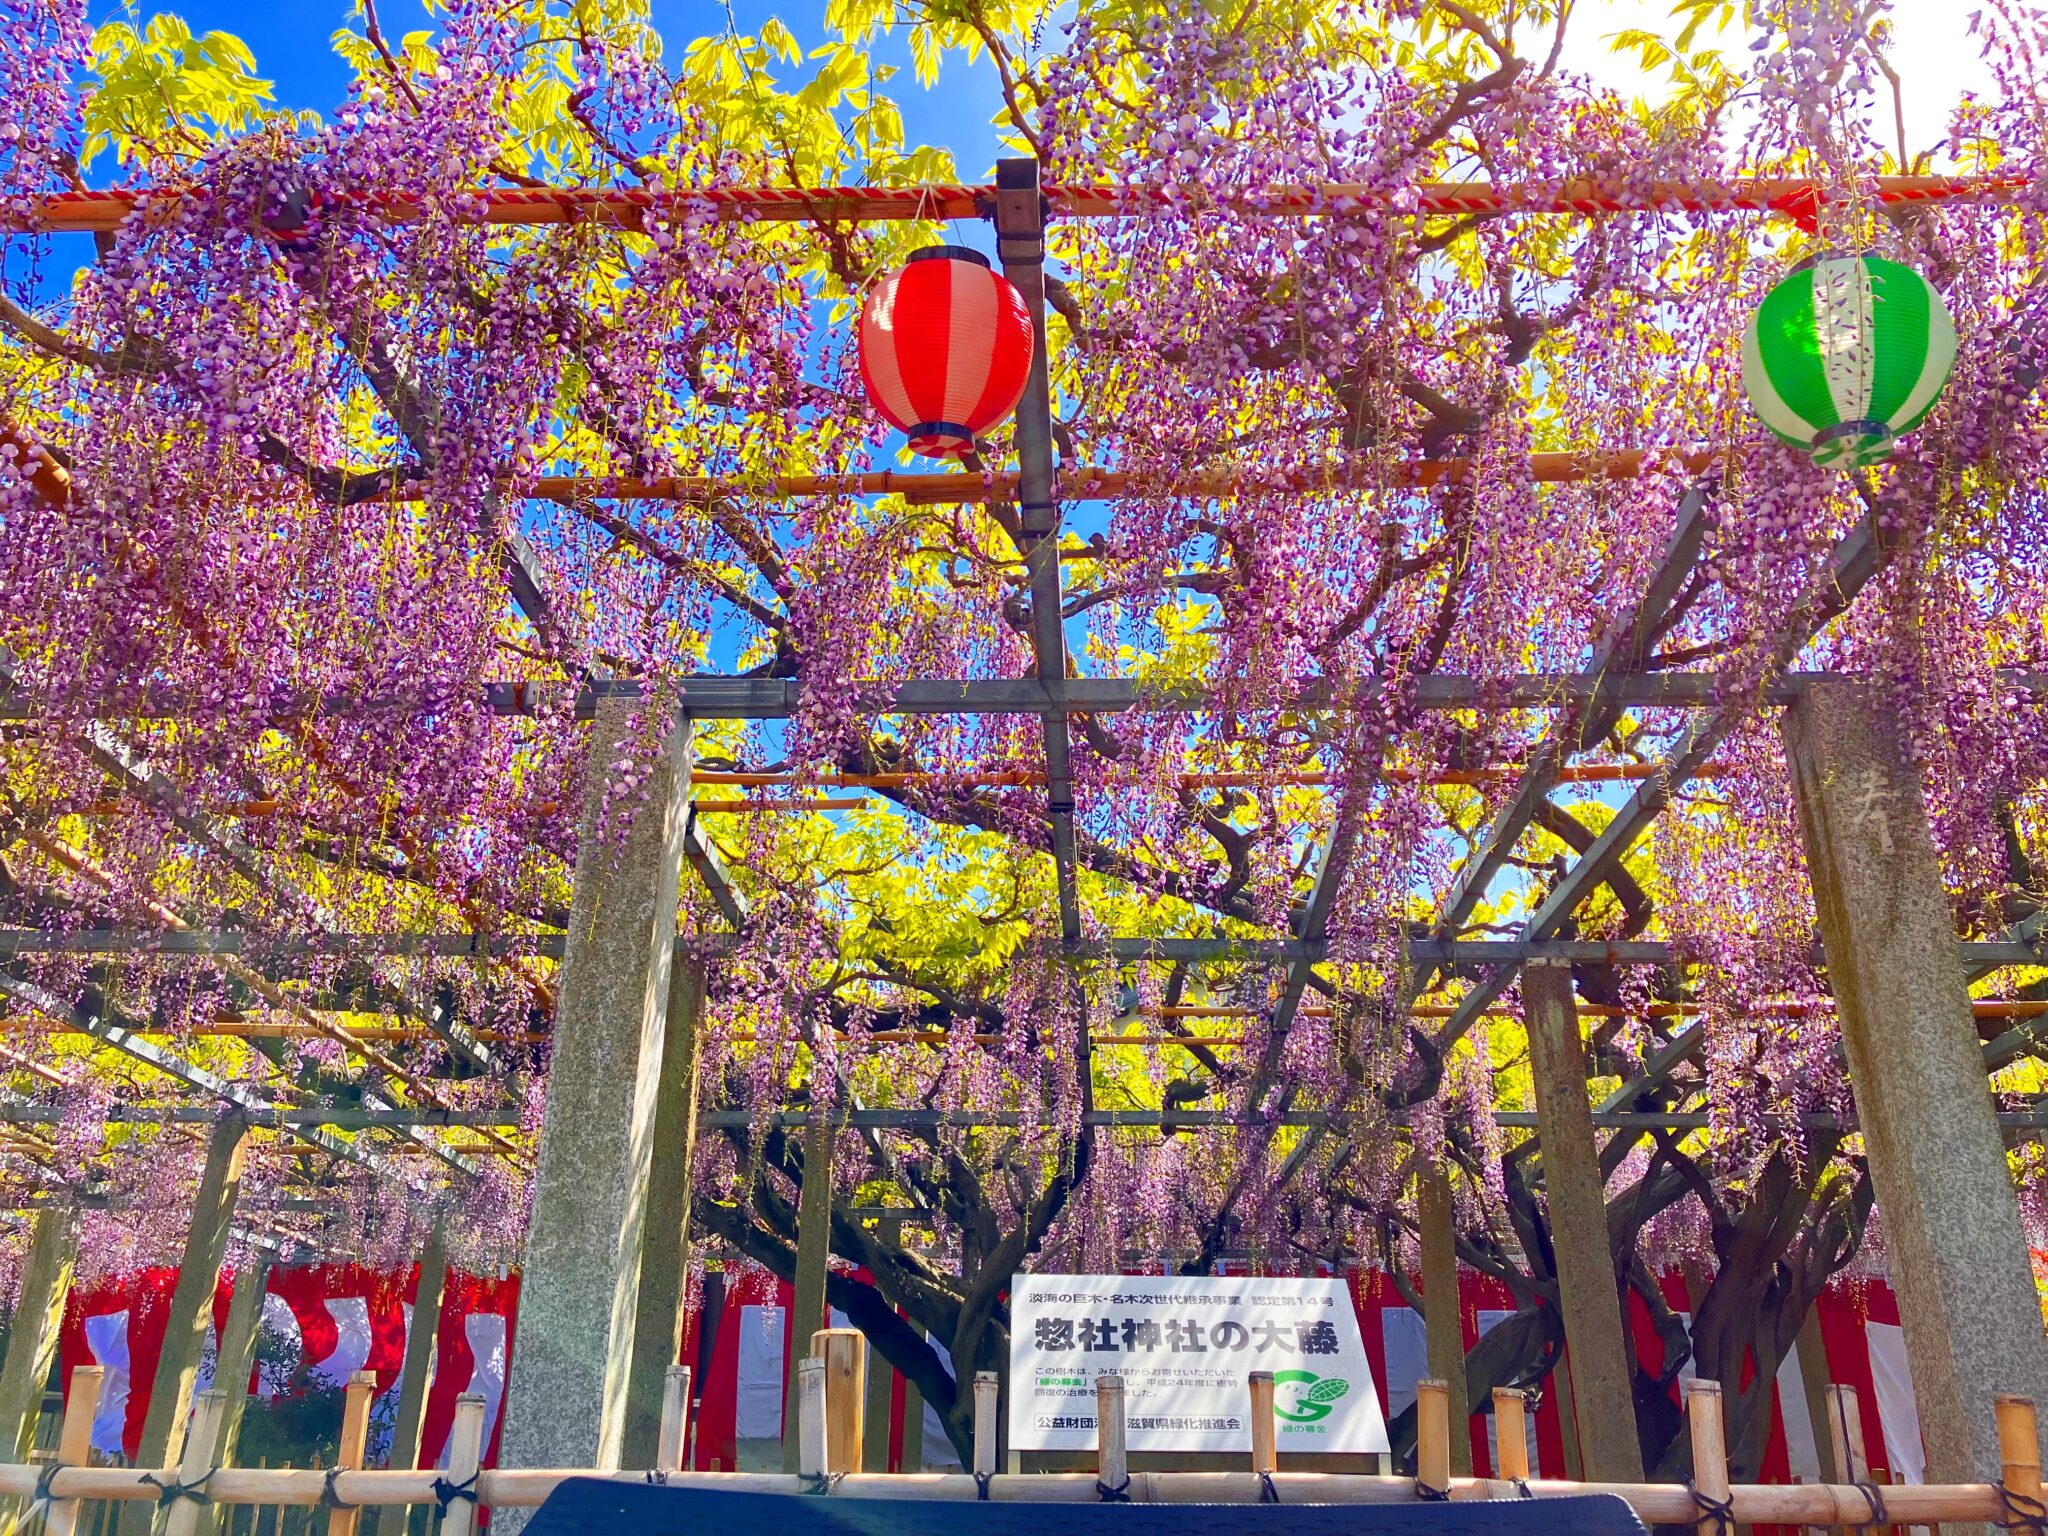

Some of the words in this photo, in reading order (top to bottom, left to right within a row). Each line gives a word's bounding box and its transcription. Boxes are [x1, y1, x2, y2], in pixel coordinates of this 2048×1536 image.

[1034, 1318, 1340, 1355] 惣社神社の大藤
[1282, 1424, 1327, 1434] 緑の募金
